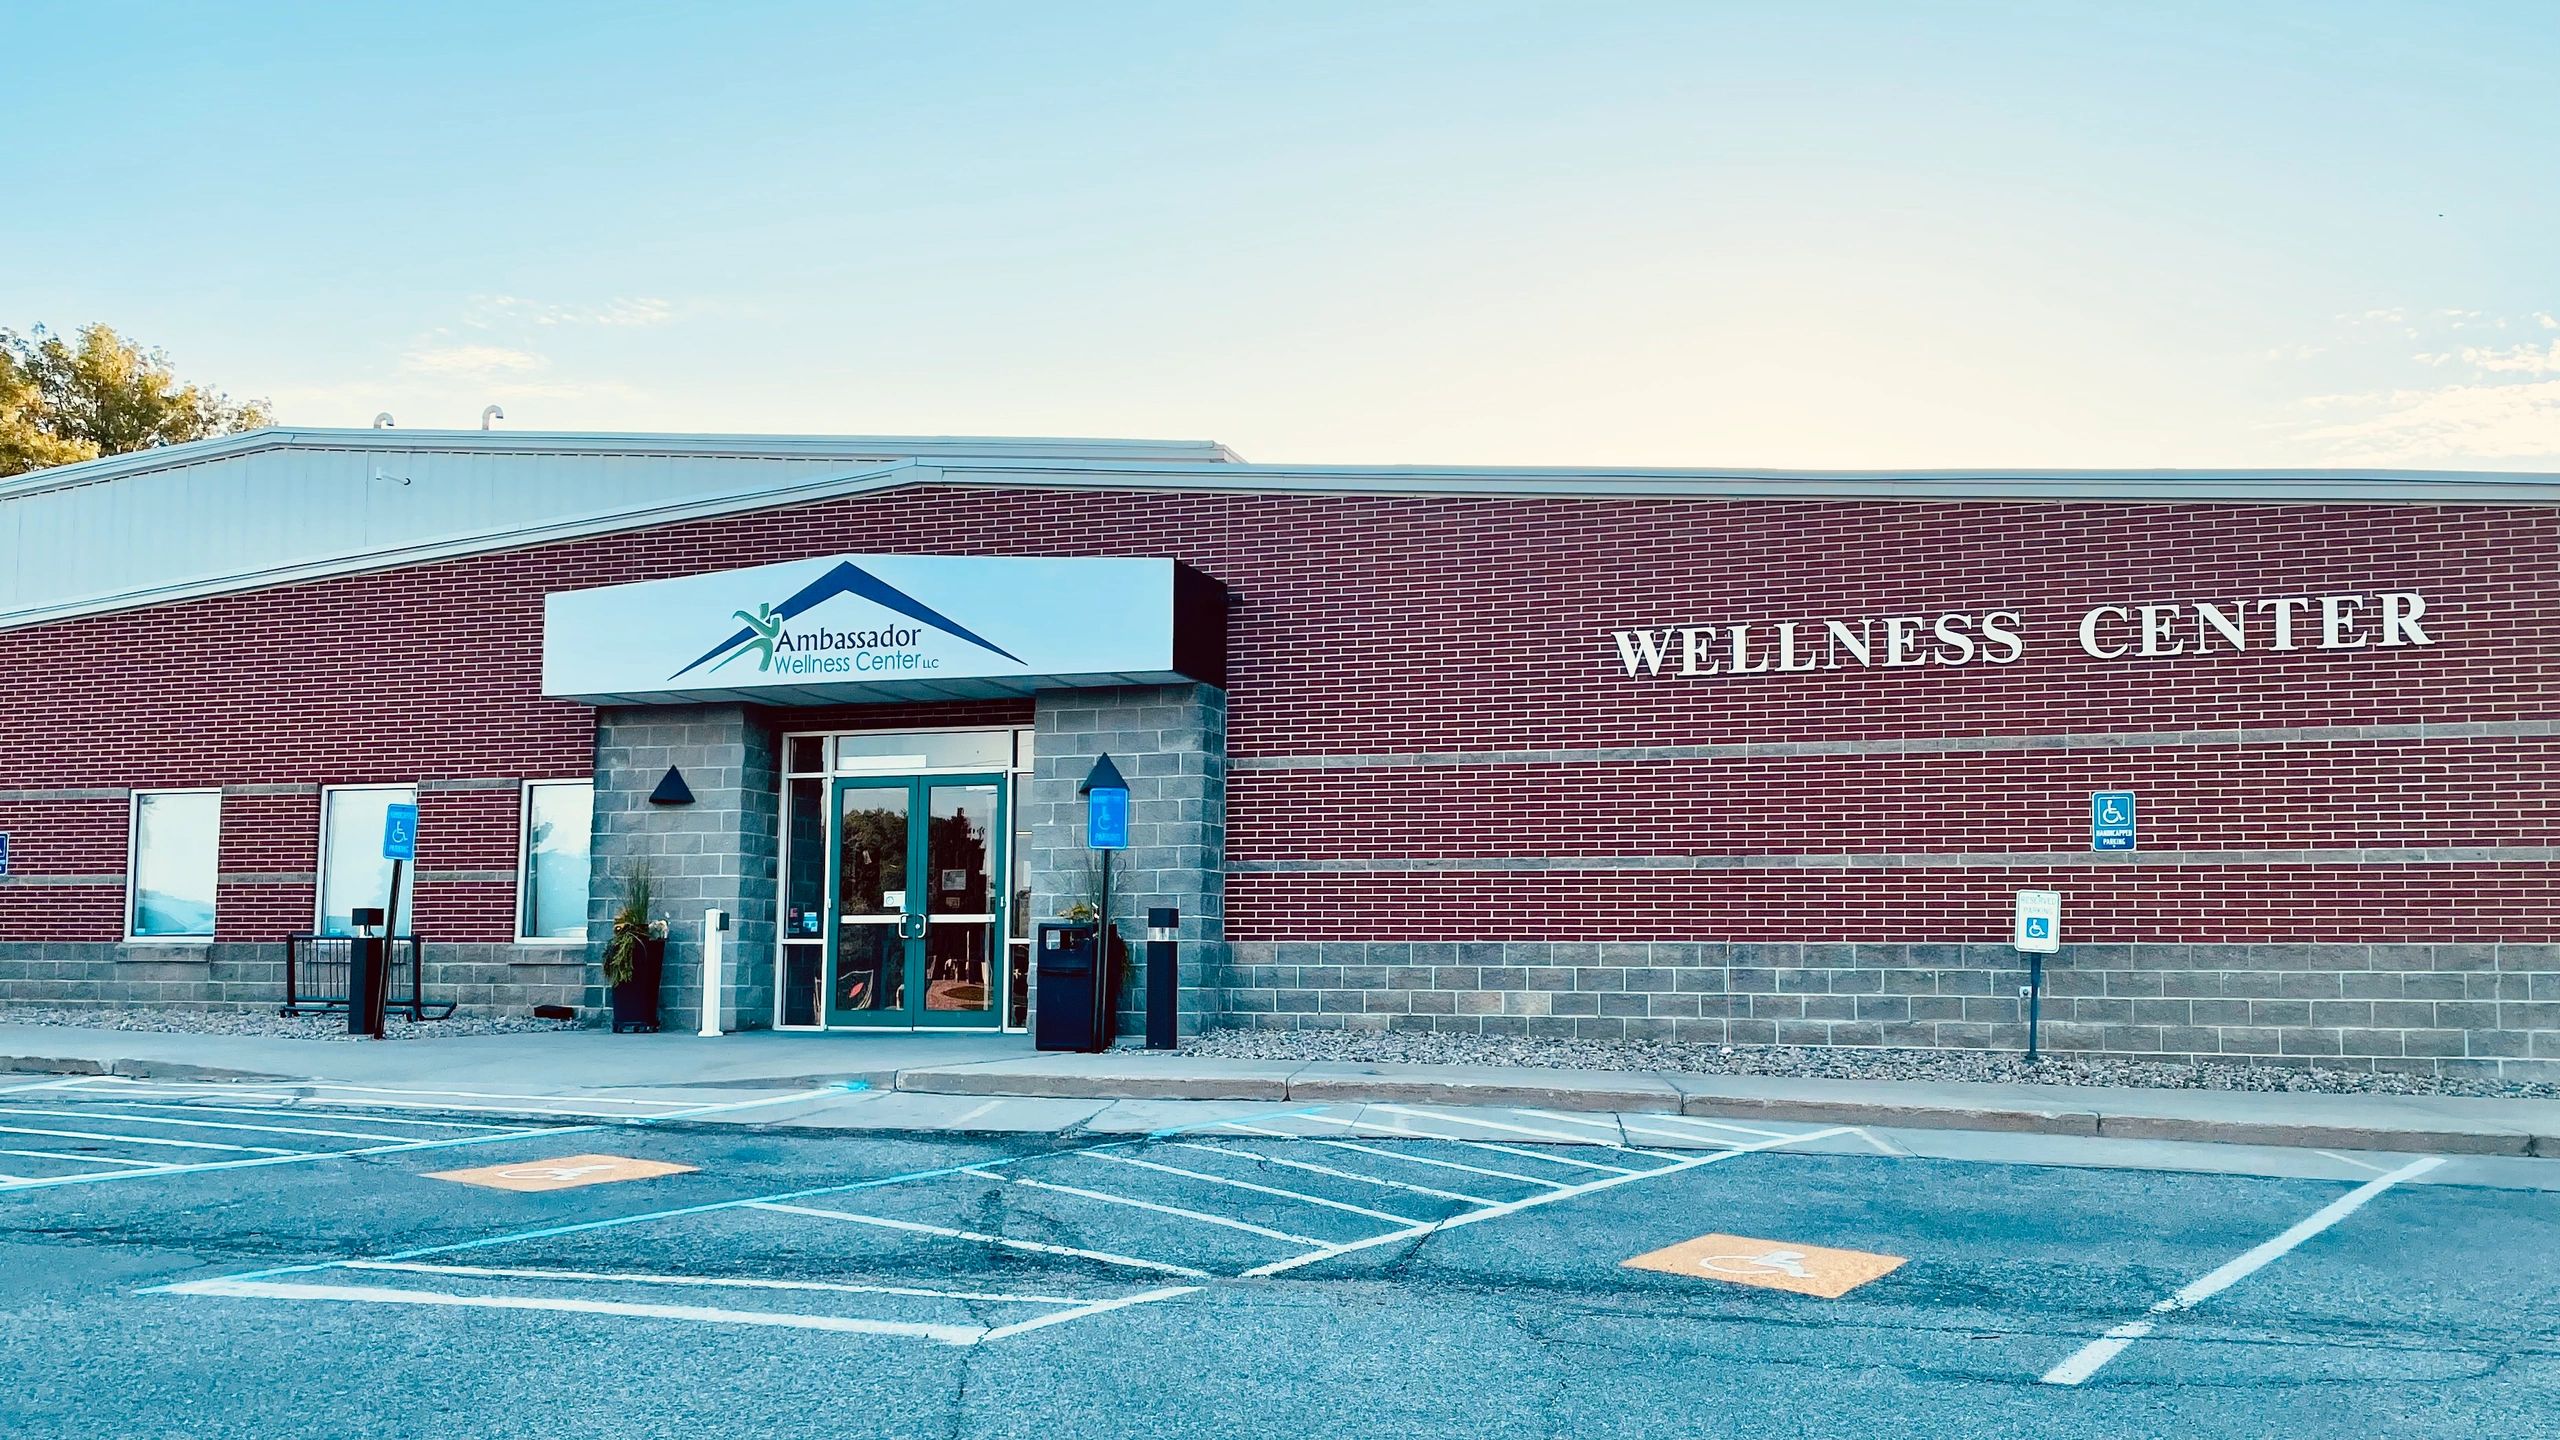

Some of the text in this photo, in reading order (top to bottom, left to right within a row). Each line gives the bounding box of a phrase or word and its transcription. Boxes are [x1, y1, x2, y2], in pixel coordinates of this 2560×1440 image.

[774, 623, 922, 652] Ambassador
[1611, 591, 2436, 679] WELLNESS CENTER
[774, 650, 939, 675] Wellness Center LLC
[2102, 838, 2126, 846] PARKING
